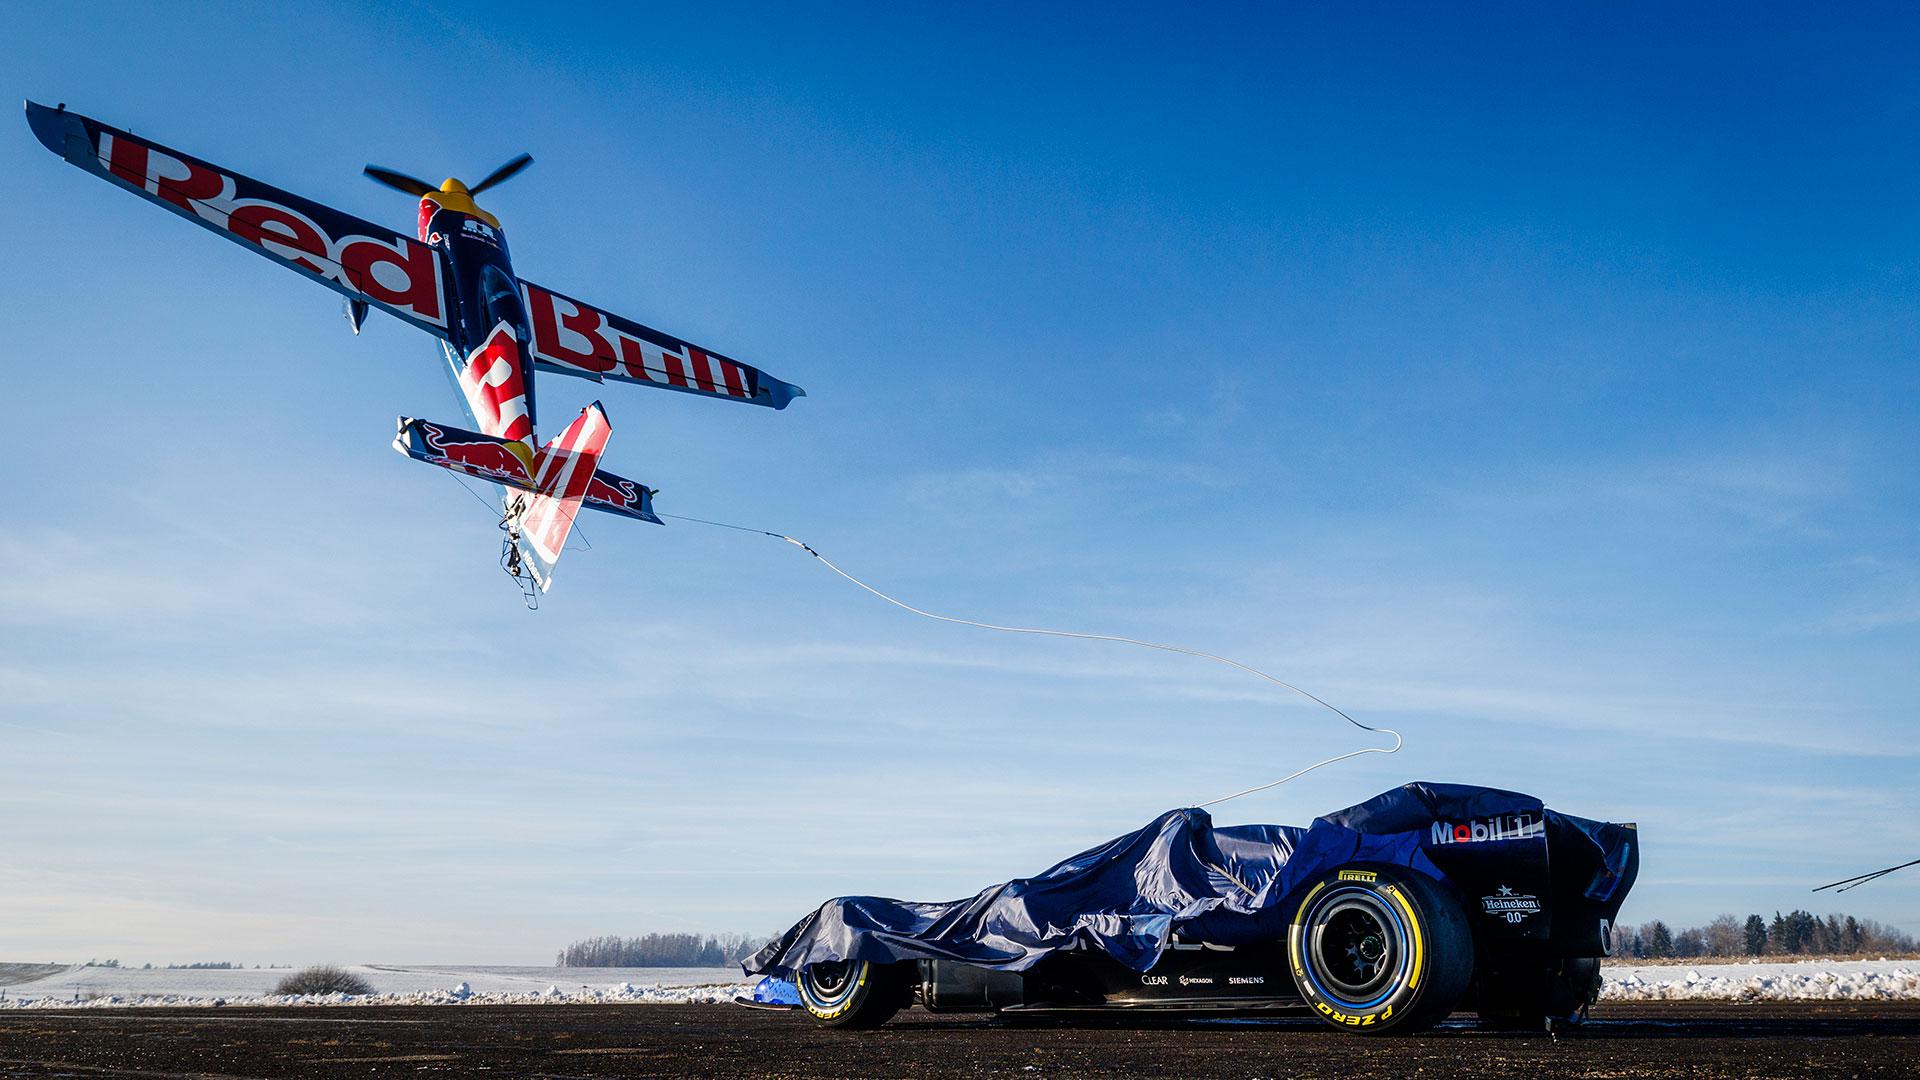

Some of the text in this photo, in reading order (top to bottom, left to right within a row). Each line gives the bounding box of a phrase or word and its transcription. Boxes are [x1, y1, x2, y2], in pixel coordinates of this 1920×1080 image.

[99, 131, 448, 328] Red
[521, 282, 752, 399] Bull
[1432, 816, 1503, 845] Mobil
[1338, 870, 1377, 882] PIRELLI
[1485, 899, 1537, 909] Heineken
[1506, 912, 1522, 923] 0.0
[1228, 976, 1265, 985] SIEMENS
[808, 998, 851, 1019] P ZERO
[1316, 1002, 1393, 1026] P ZERO
